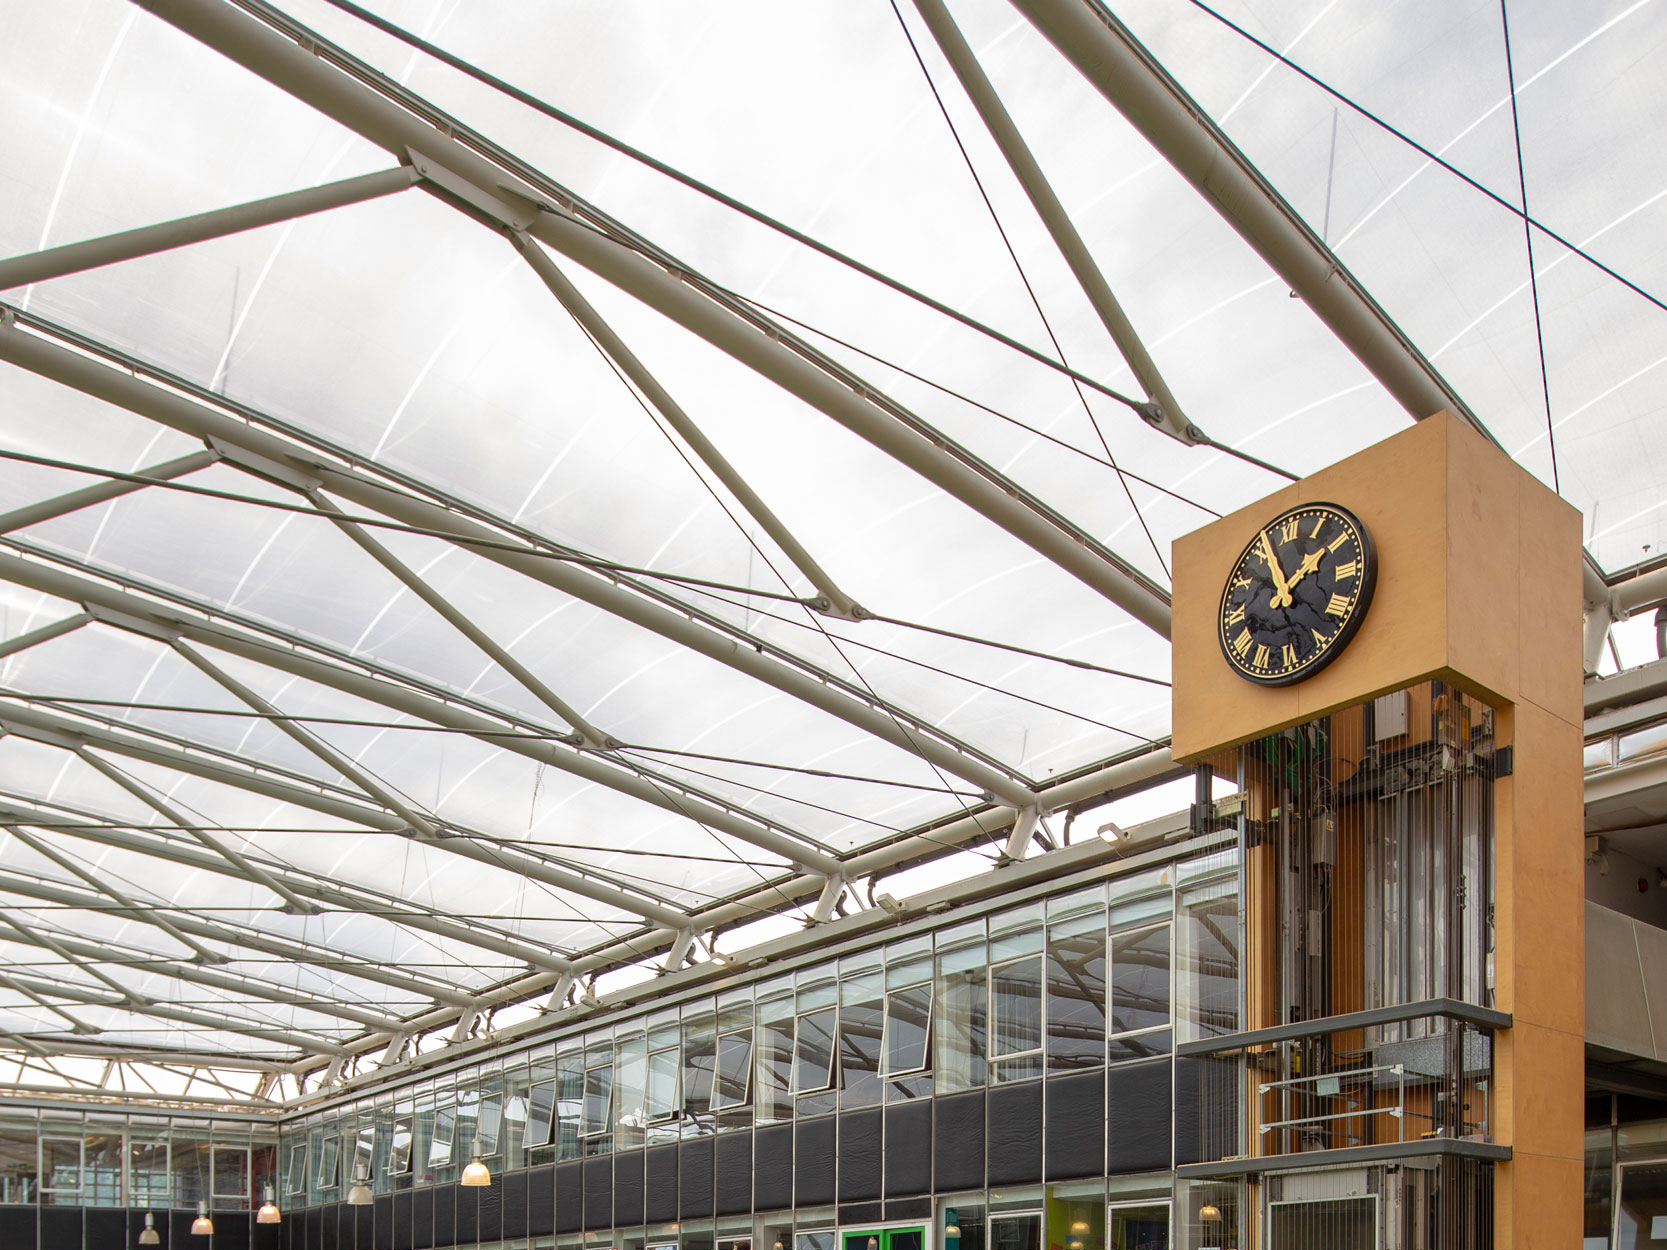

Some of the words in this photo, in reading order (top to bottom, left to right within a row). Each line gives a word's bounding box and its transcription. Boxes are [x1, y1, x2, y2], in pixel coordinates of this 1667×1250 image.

[1279, 520, 1299, 546] XII
[1309, 517, 1326, 539] I
[1327, 531, 1350, 555] II
[1235, 575, 1253, 590] X
[1335, 559, 1356, 582] III
[1229, 602, 1245, 627] IX
[1325, 592, 1351, 618] IIII
[1233, 626, 1255, 659] VIII
[1311, 628, 1328, 649] V
[1252, 643, 1271, 669] VII
[1281, 642, 1299, 667] VI
